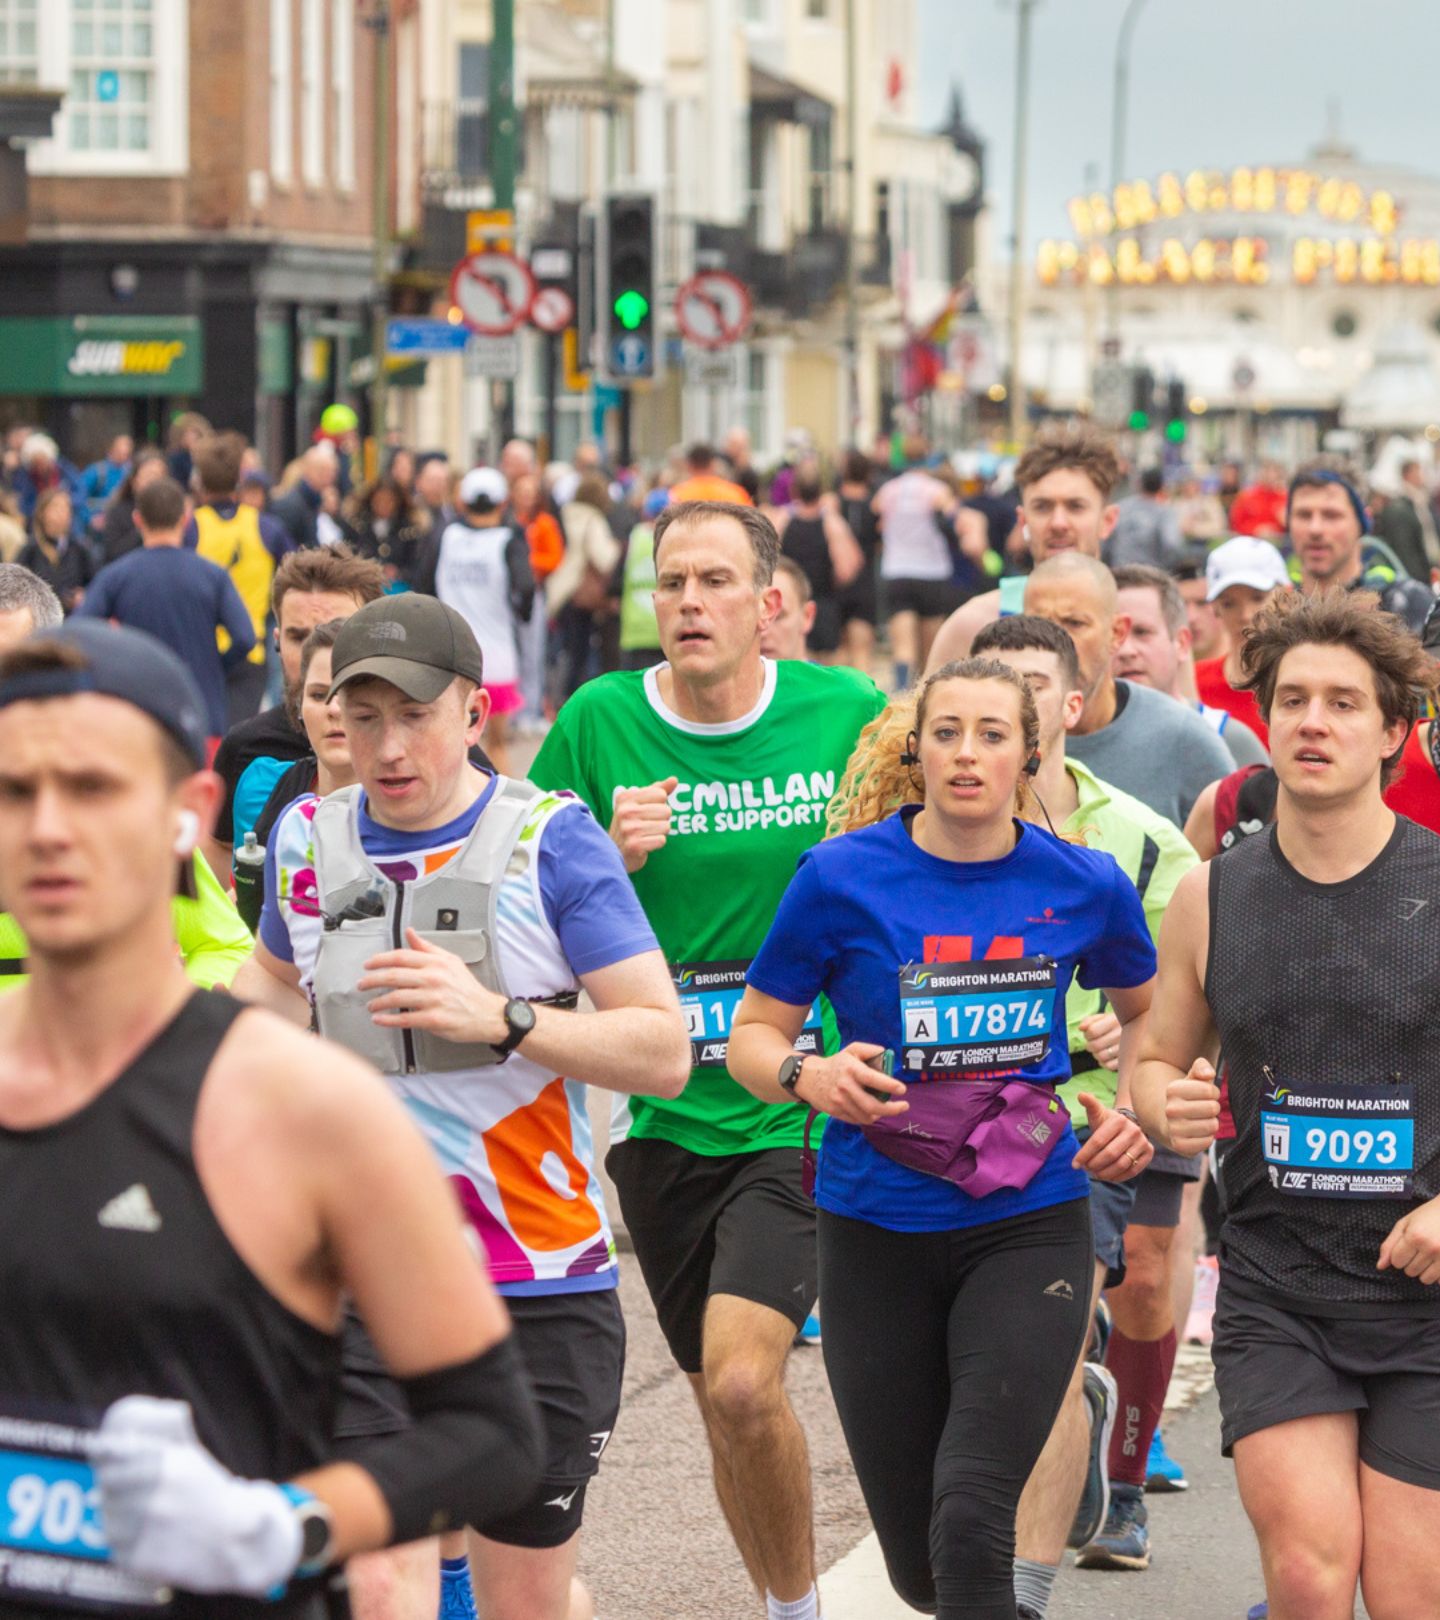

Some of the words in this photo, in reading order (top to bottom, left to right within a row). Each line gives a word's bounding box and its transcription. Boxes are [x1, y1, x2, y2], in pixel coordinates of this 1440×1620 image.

[67, 340, 185, 375] SUBWAY
[612, 770, 835, 813] CMILLAN
[668, 813, 709, 836] CER
[714, 802, 825, 833] SUPPORT
[695, 971, 746, 986] BRIGHTON
[930, 974, 988, 989] BRIGHTON
[990, 969, 1051, 985] MARATHON
[914, 1018, 930, 1038] A
[944, 998, 1046, 1039] 17874
[962, 1048, 998, 1058] LONDON
[1000, 1040, 1043, 1053] MARATHON
[962, 1055, 993, 1065] EVENTS
[1287, 1095, 1344, 1110] BRIGHTON
[1347, 1099, 1410, 1111] MARATHON
[1271, 1134, 1282, 1155] H
[1306, 1128, 1397, 1164] 9093
[1312, 1173, 1350, 1183] LONDON
[1351, 1174, 1404, 1184] MARATHON
[1312, 1182, 1345, 1191] EVENTS
[7, 1473, 107, 1550] 903
